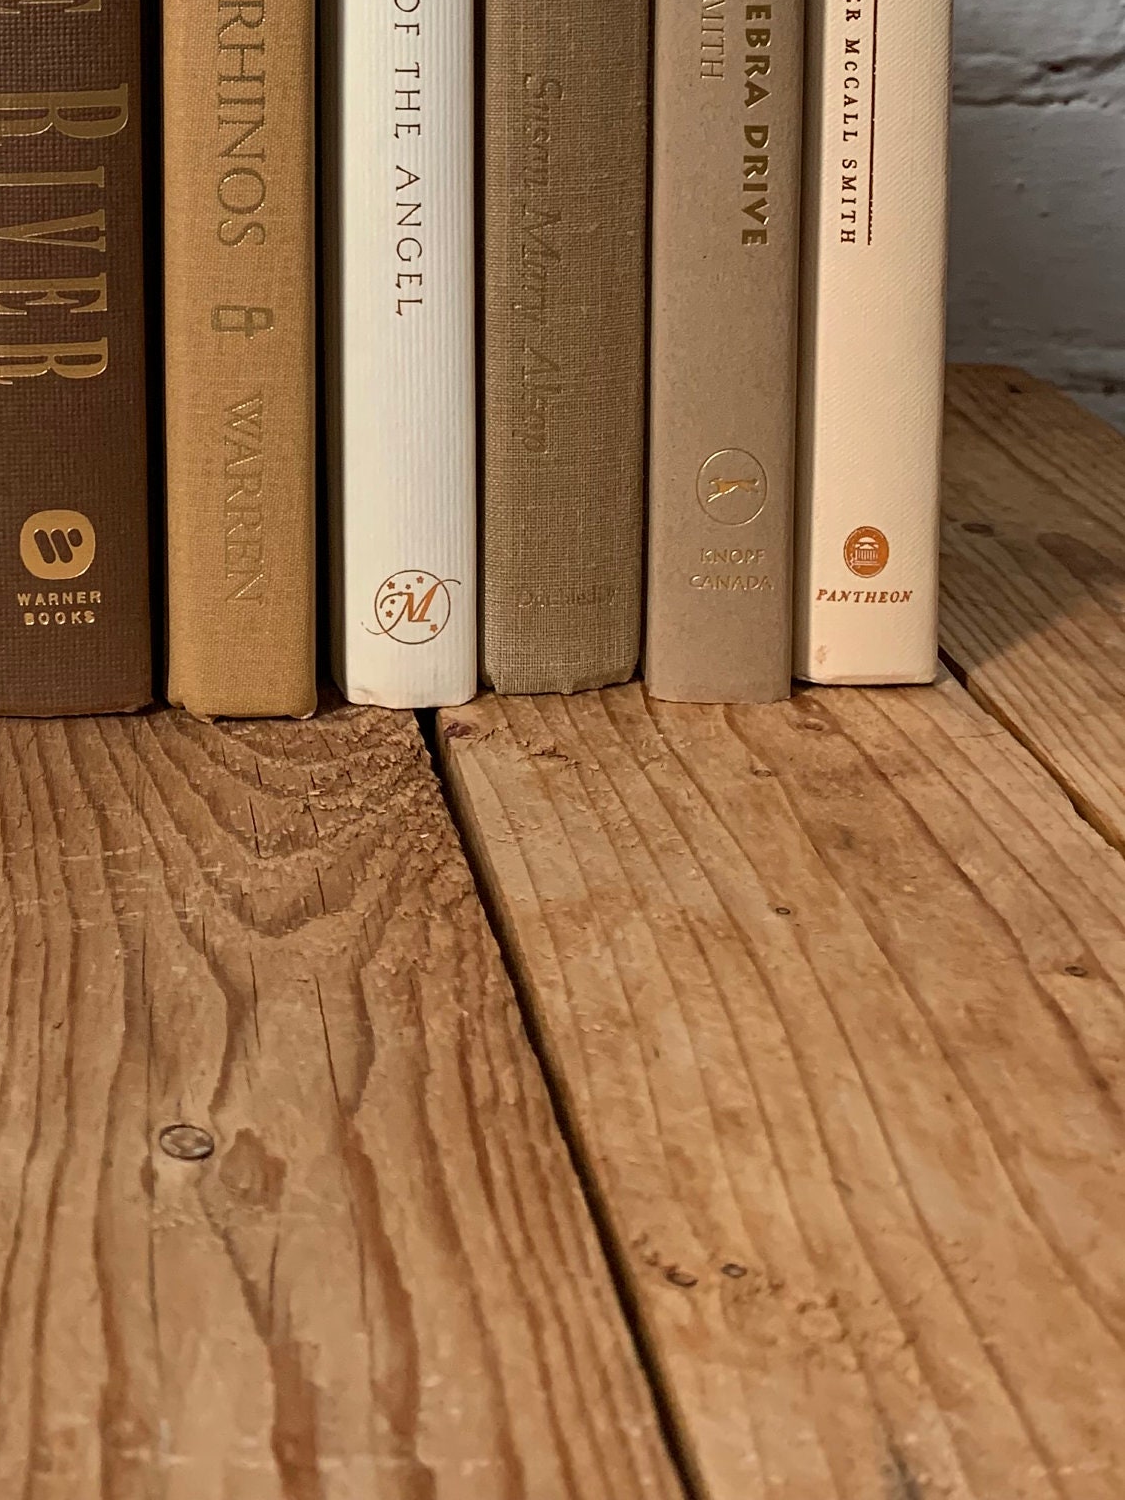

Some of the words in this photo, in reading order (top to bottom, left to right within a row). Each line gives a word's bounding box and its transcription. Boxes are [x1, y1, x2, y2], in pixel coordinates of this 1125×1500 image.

[393, 61, 422, 139] THE
[741, 124, 770, 247] DRIVE
[840, 158, 859, 245] SMITH
[394, 164, 424, 317] ANGEL
[223, 397, 265, 605] WARREN
[699, 547, 766, 565] KNOPF
[17, 590, 102, 607] WARNER
[688, 573, 775, 591] CANADA
[815, 588, 914, 604] PANTHEON
[23, 609, 96, 626] BOOKS
